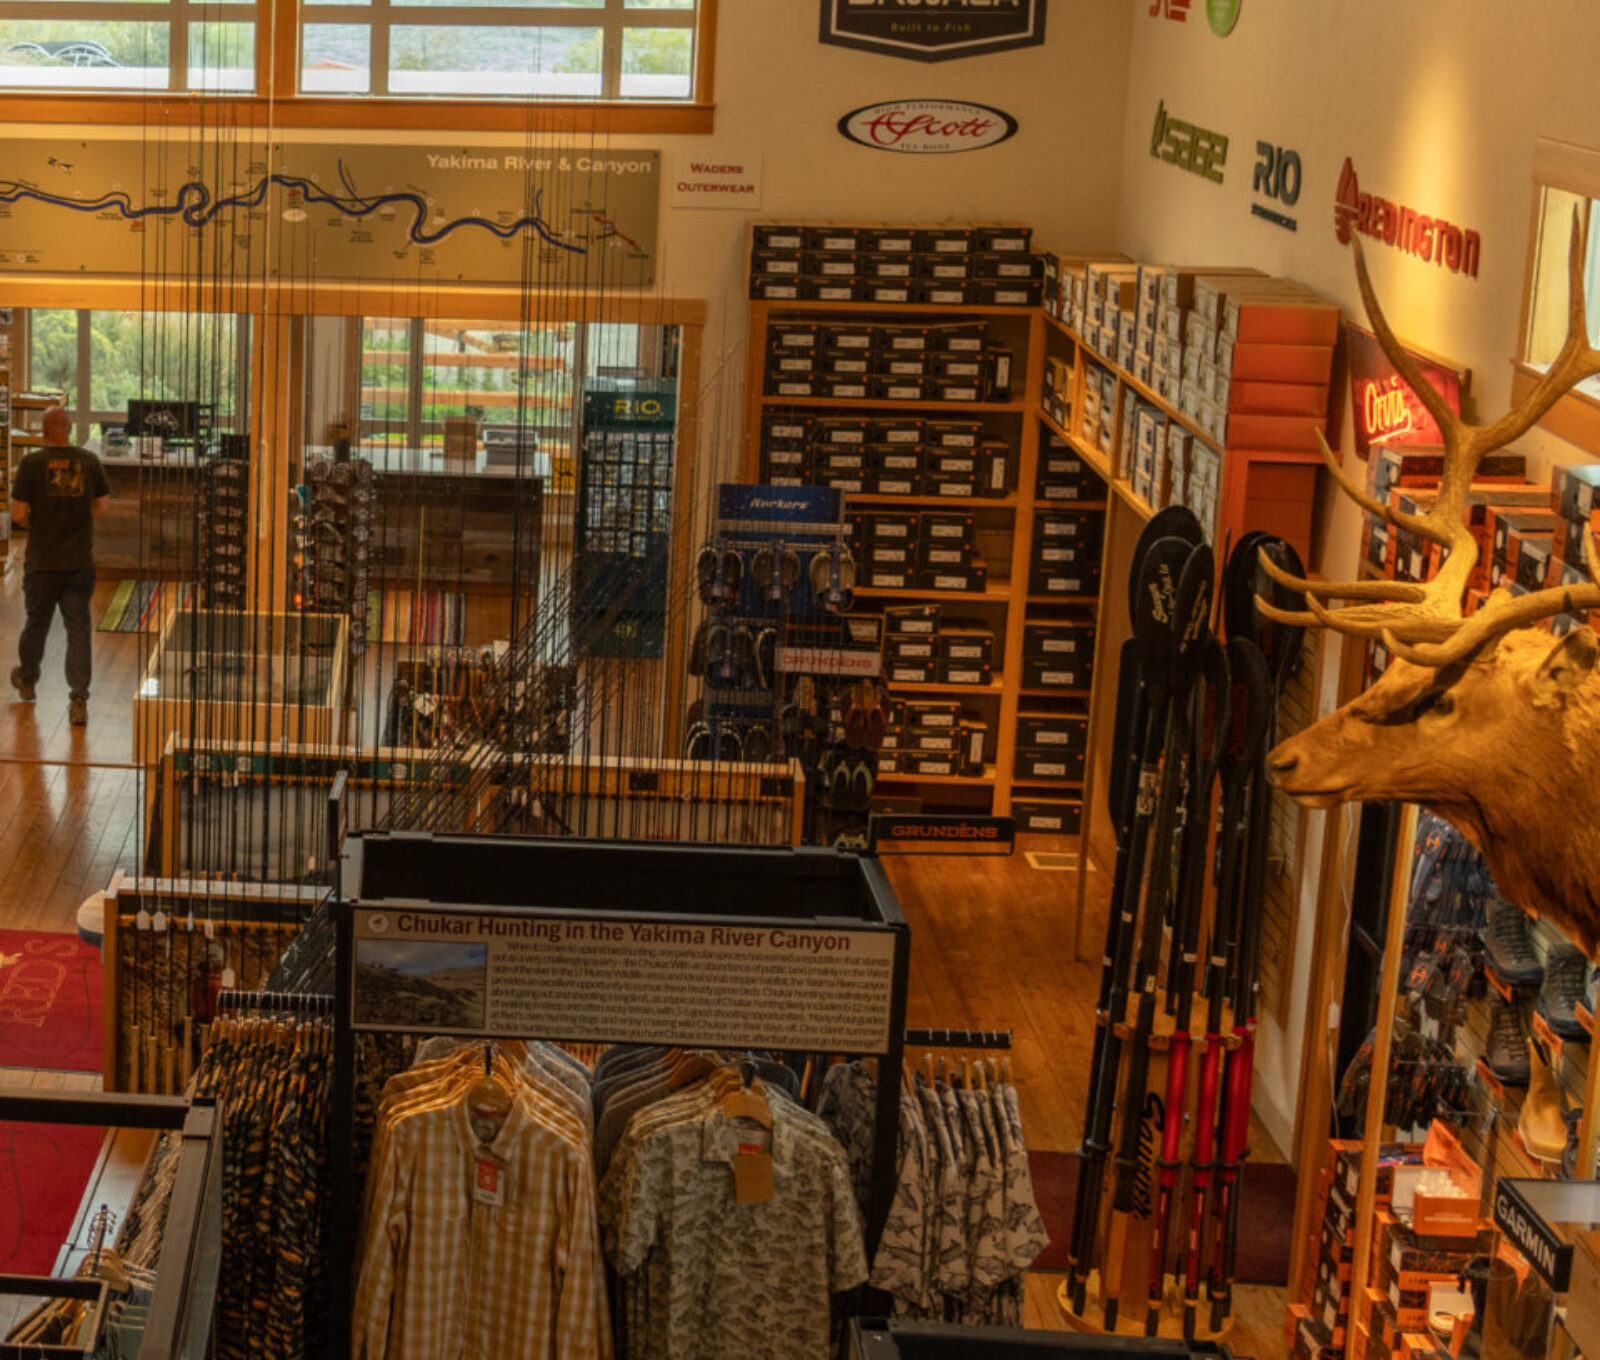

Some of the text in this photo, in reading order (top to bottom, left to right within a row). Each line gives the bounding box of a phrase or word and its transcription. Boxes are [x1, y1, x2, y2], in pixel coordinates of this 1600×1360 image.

[426, 154, 652, 175] Yakima River & Canyon
[1253, 139, 1302, 207] RIO
[613, 399, 662, 416] RIO
[397, 915, 850, 953] Chukar Hunting in the Yakima River Canyon
[1497, 1195, 1556, 1277] GARMIN
